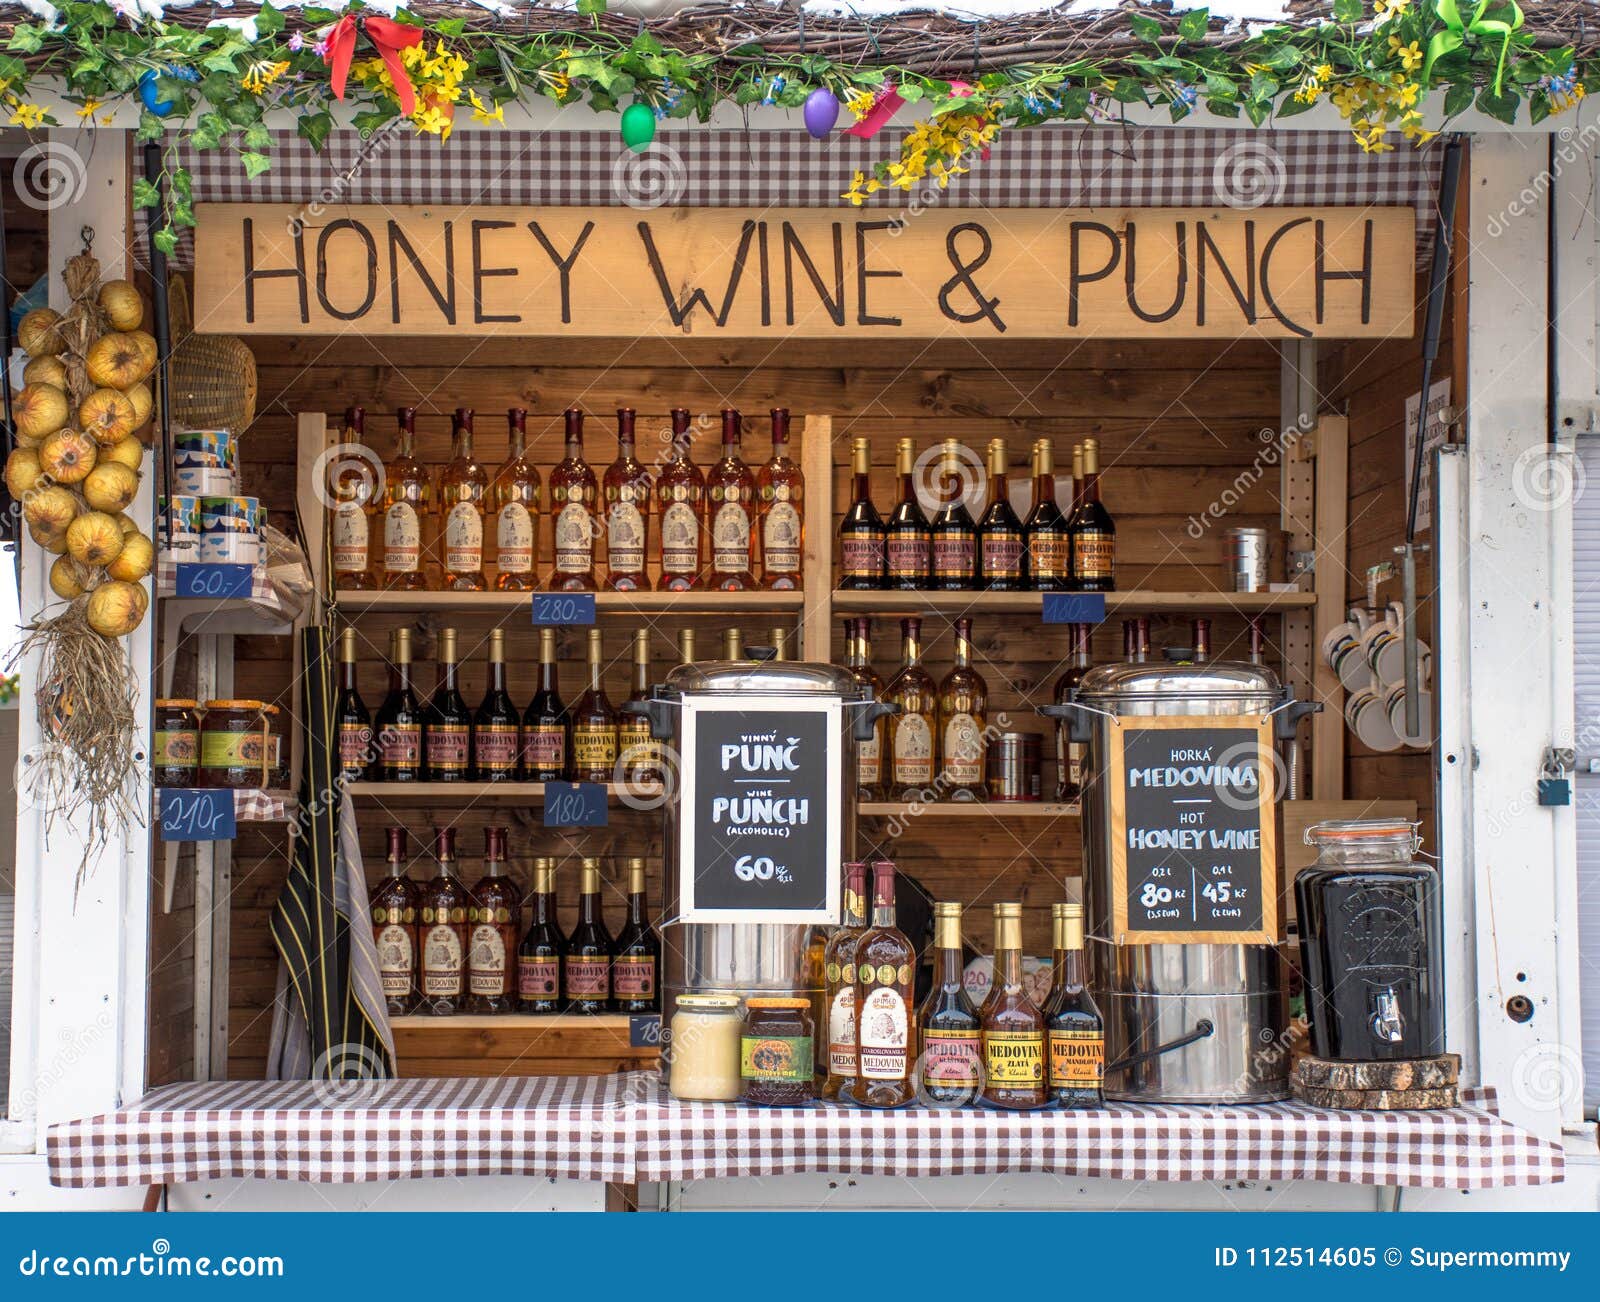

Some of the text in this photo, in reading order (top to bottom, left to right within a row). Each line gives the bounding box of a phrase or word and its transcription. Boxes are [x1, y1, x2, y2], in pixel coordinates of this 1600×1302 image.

[242, 217, 1373, 338] HONEY WINE & PUNCH
[741, 730, 776, 743] VINNÝ
[721, 737, 801, 771] PUNČ
[1171, 746, 1213, 762] HORKÁ
[1129, 766, 1258, 787] MEDOVINA
[747, 790, 772, 798] WINE
[712, 797, 808, 825] PUNCH
[1180, 812, 1205, 824] HOT
[726, 826, 790, 838] (ALCOHOLIC)
[1129, 827, 1261, 850] HONEY WINE
[734, 855, 775, 881] 60
[1140, 883, 1172, 908] 80
[1201, 882, 1231, 904] 45
[640, 1020, 662, 1044] 18
[864, 1057, 904, 1068] MEDOVINA
[1007, 1058, 1029, 1068] ZLATÁ
